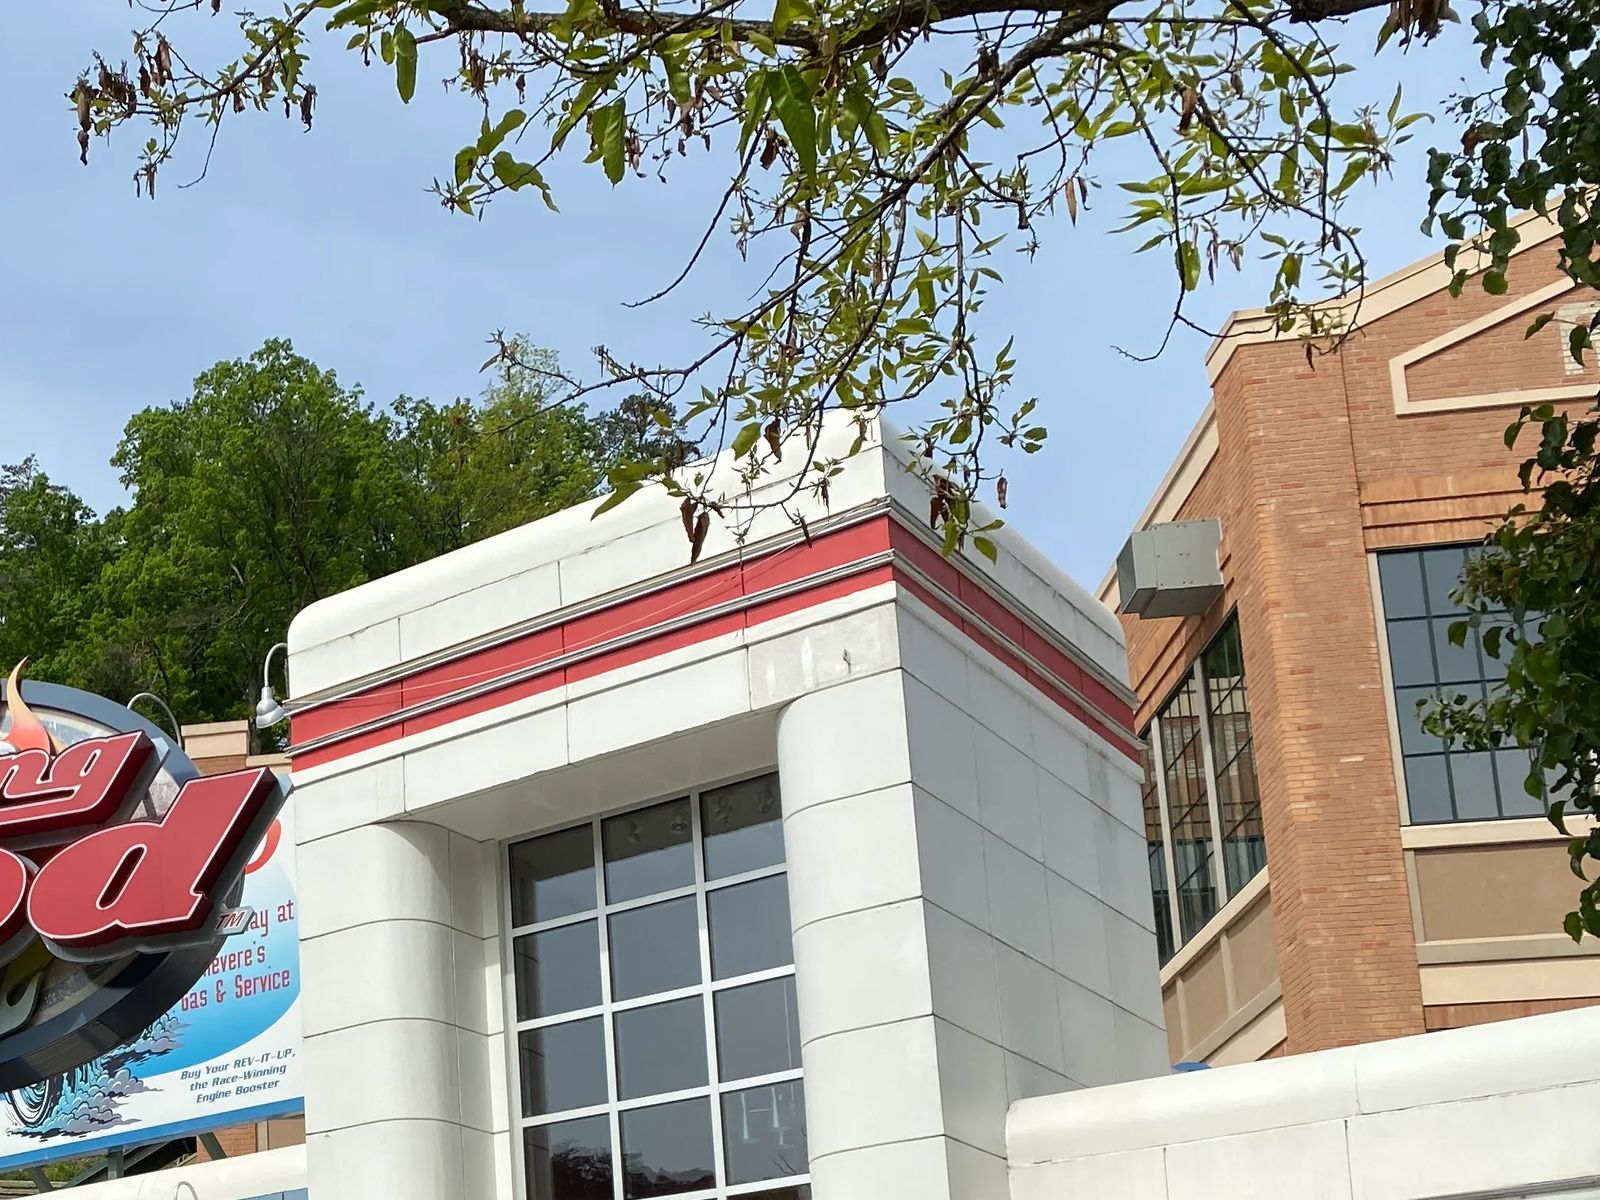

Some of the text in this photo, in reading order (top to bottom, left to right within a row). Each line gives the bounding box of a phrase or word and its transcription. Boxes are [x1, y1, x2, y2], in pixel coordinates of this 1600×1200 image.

[217, 909, 246, 931] TM
[249, 899, 295, 938] ay at
[216, 979, 227, 1003] &
[235, 969, 290, 1000] Service
[180, 1068, 201, 1083] Buy
[206, 1061, 231, 1076] Your
[190, 1063, 287, 1091] the Race-Winning
[196, 1078, 280, 1104] Engine Booster
